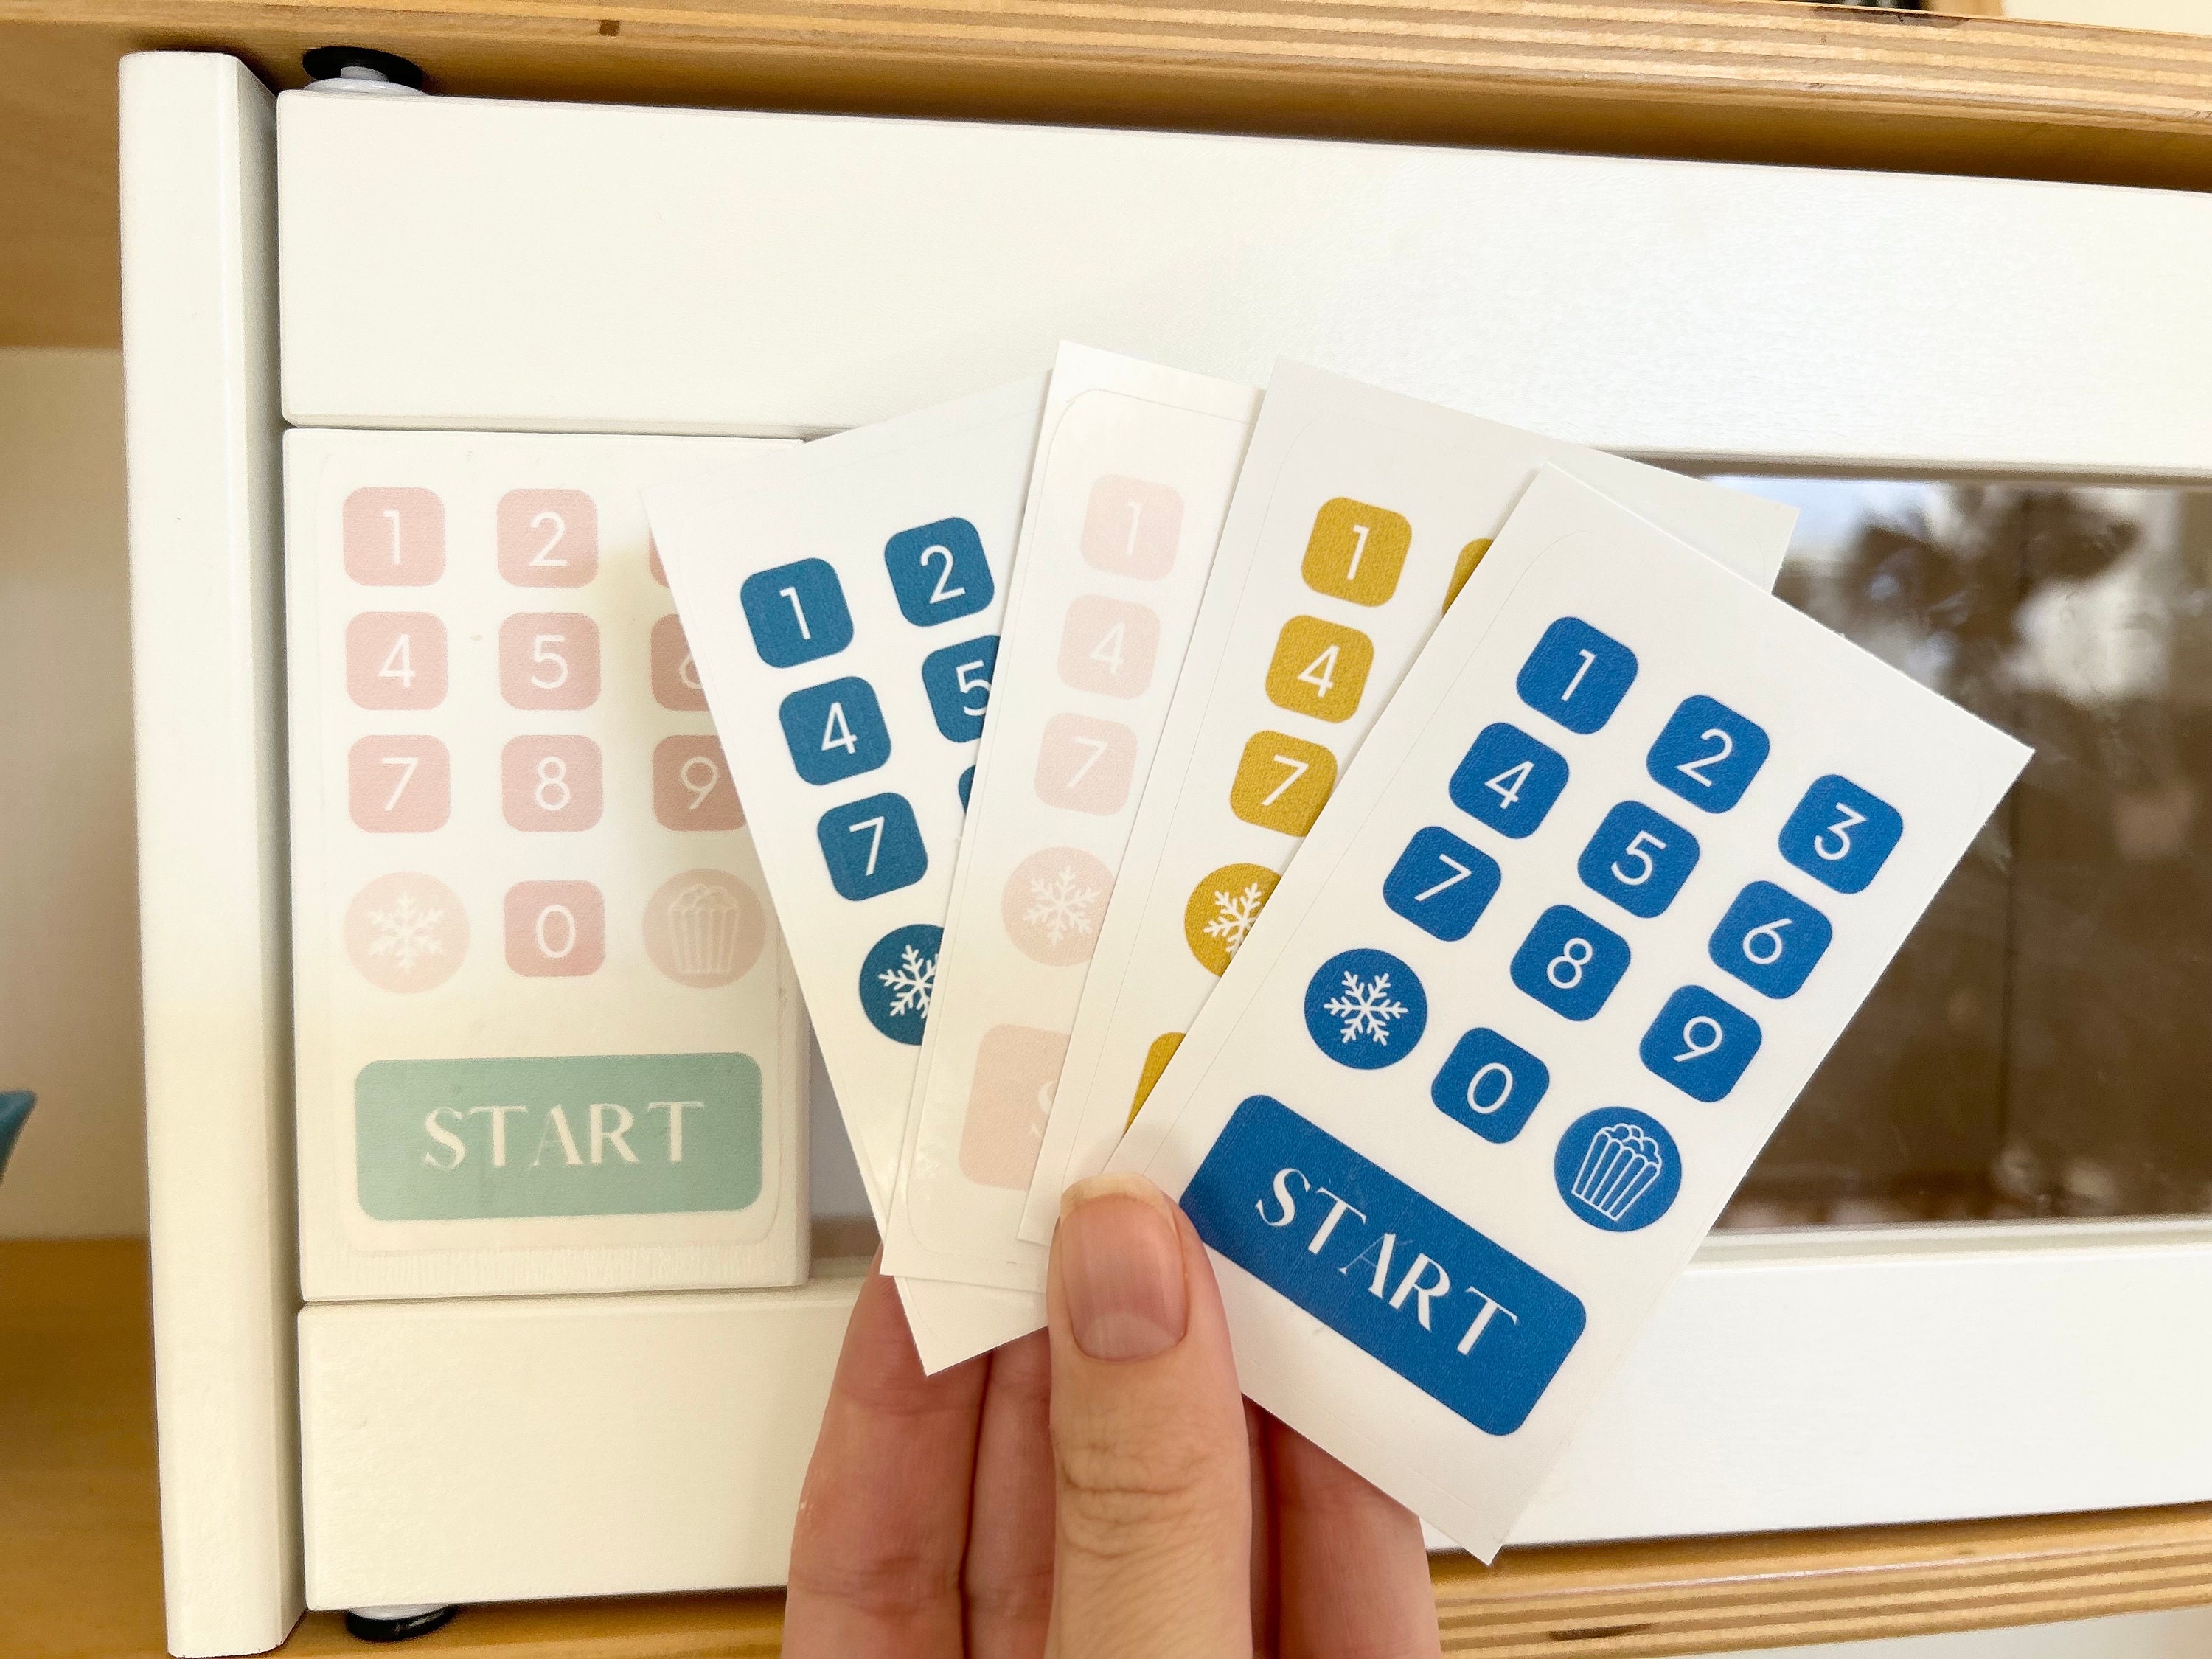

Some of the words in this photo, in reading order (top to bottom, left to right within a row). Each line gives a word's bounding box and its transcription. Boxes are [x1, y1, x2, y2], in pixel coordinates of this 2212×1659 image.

[382, 509, 401, 565] 1
[529, 511, 568, 566] 2
[1124, 501, 1142, 556] 1
[1347, 524, 1370, 580] 1
[779, 586, 811, 640] 1
[920, 545, 965, 604] 2
[378, 633, 416, 688] 4
[529, 633, 568, 689] 5
[1089, 621, 1126, 675] 4
[1298, 644, 1340, 698] 4
[821, 702, 858, 754] 4
[956, 660, 992, 717] 5
[1066, 737, 1108, 788] 7
[1262, 754, 1309, 807] 7
[1561, 649, 1596, 701] 1
[1677, 728, 1733, 787] 2
[1814, 802, 1867, 861] 3
[380, 757, 419, 811] 7
[534, 756, 571, 811] 8
[680, 756, 719, 810] 9
[849, 816, 885, 876] 7
[1484, 760, 1534, 809] 4
[1611, 830, 1666, 886] 5
[1742, 918, 1792, 965] 6
[535, 904, 576, 959] 0
[1415, 854, 1472, 902] 7
[1546, 937, 1593, 990] 8
[1674, 1015, 1723, 1062] 9
[1467, 1062, 1514, 1114] 0
[424, 1101, 705, 1170] START
[1254, 1167, 1519, 1357] START
